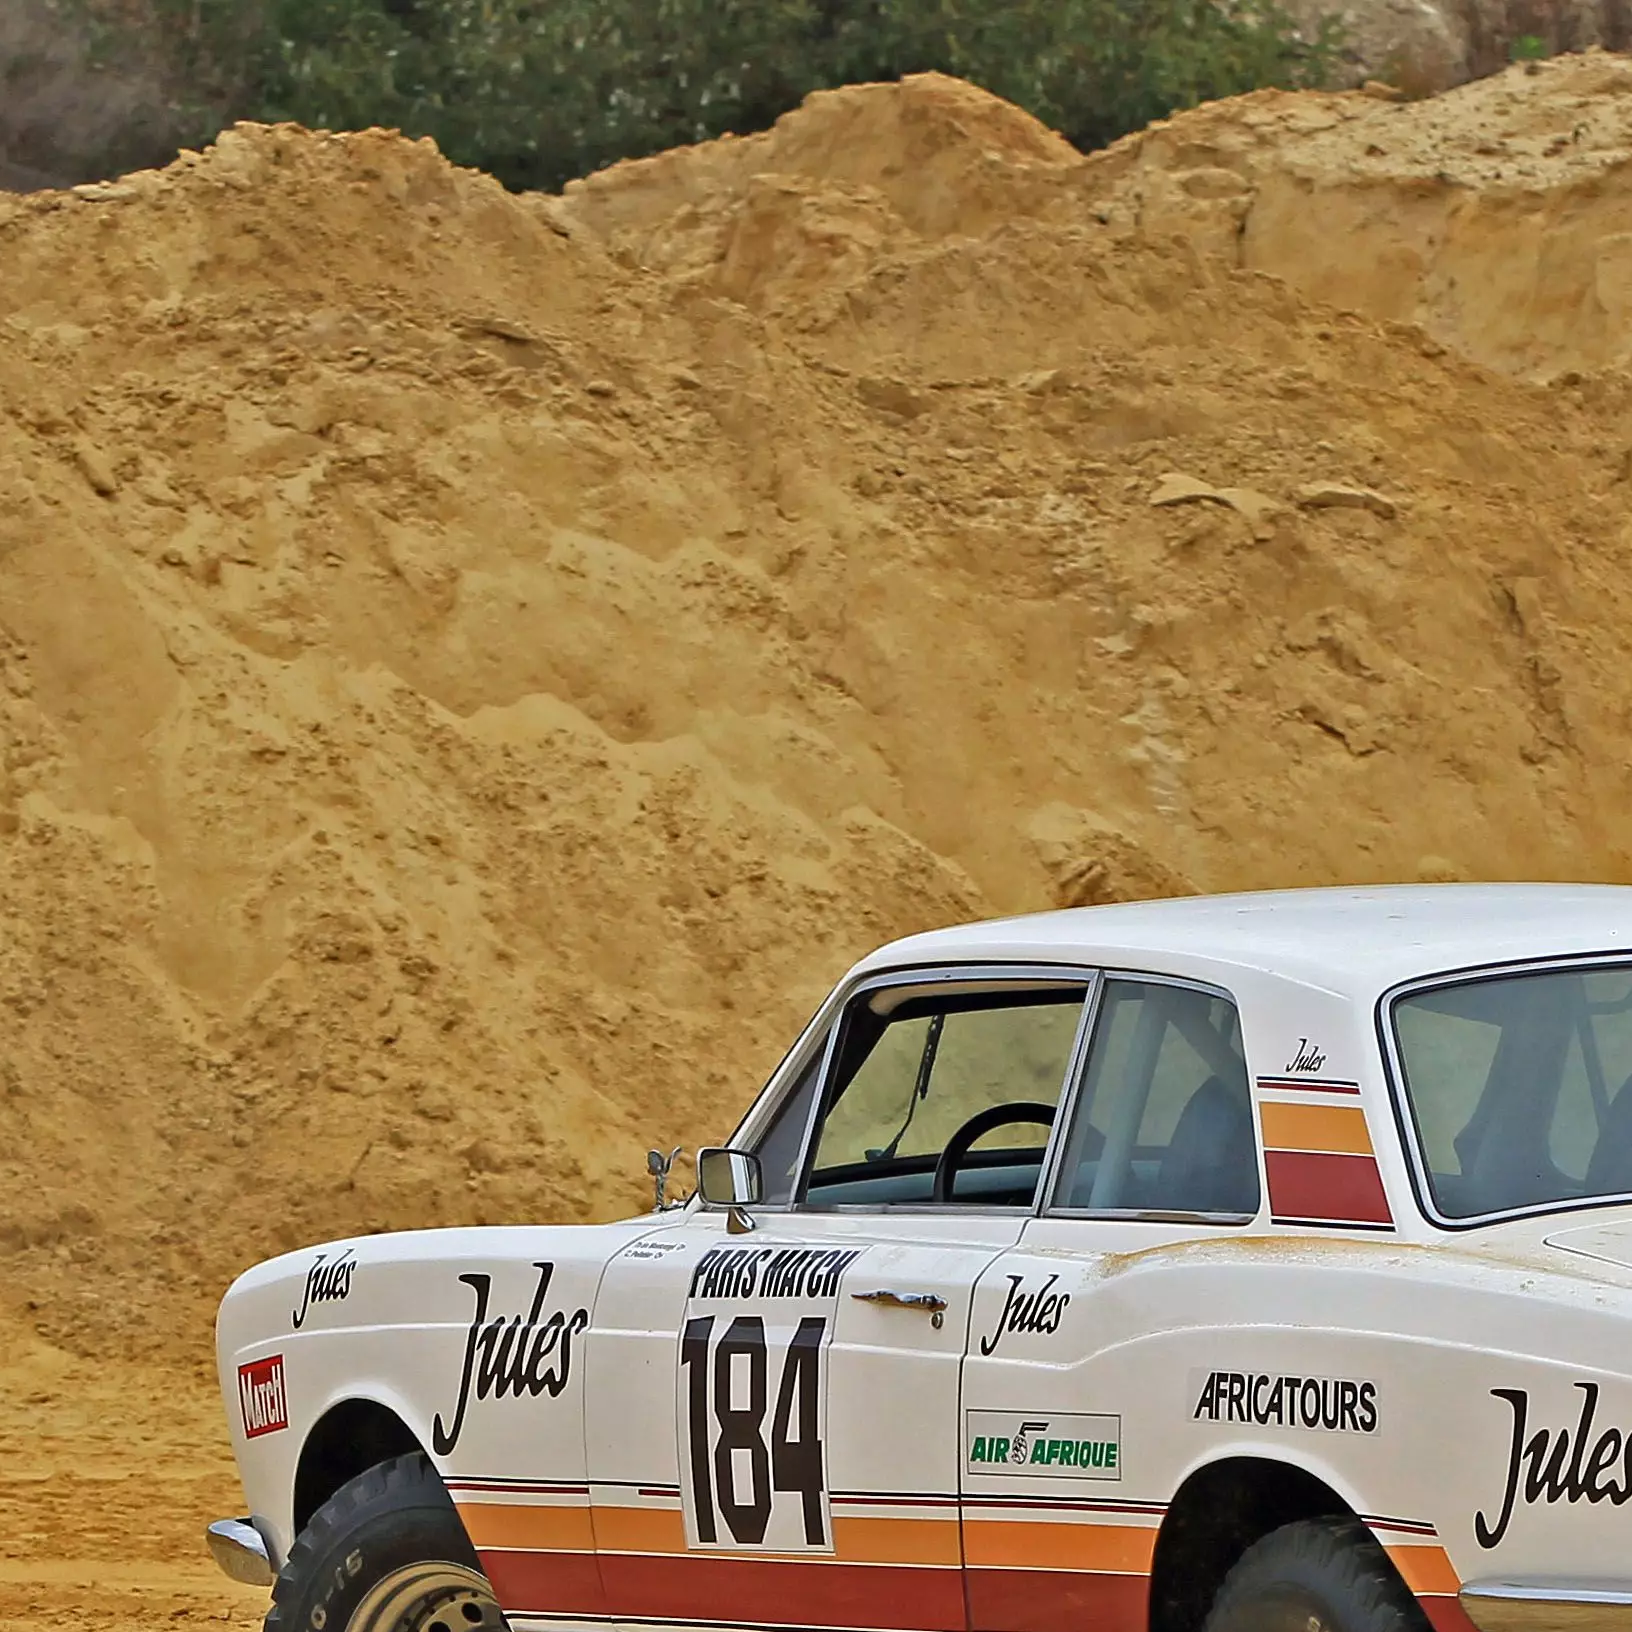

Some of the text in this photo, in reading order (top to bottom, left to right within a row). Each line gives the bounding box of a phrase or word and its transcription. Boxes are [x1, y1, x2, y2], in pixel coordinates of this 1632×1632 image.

[1285, 1037, 1327, 1073] Jules
[292, 1247, 358, 1329] Jules
[688, 1249, 862, 1299] PARIS MATCH
[980, 1273, 1071, 1357] Jules
[432, 1261, 589, 1457] Jules
[240, 1363, 286, 1433] MATCH
[680, 1314, 827, 1546] 184
[1193, 1370, 1378, 1432] AFRICATOURS
[969, 1436, 1118, 1469] AIR AFRIQUE
